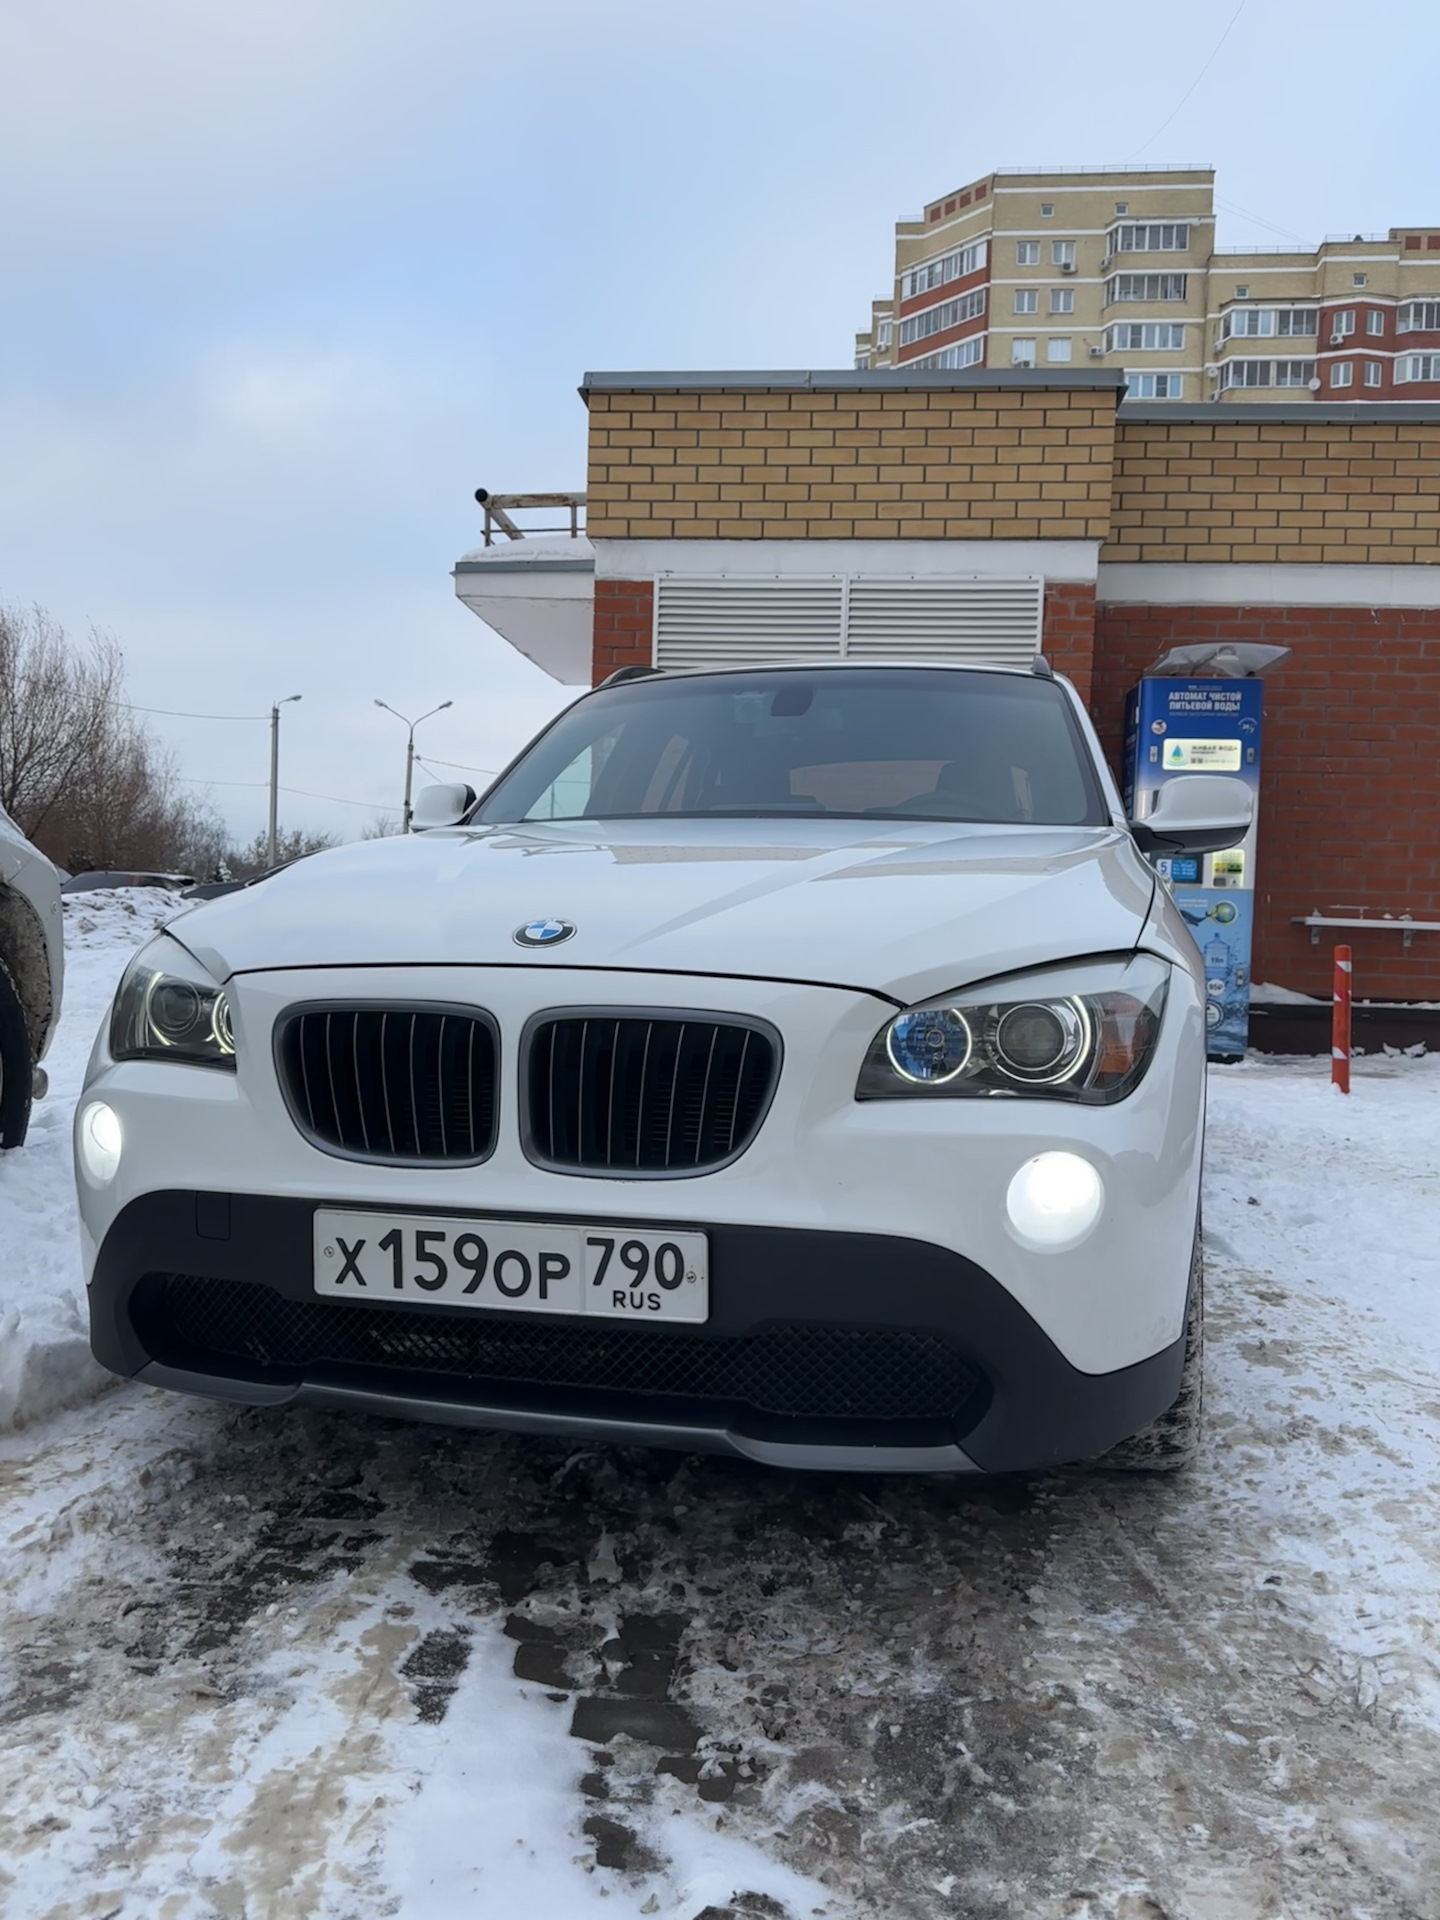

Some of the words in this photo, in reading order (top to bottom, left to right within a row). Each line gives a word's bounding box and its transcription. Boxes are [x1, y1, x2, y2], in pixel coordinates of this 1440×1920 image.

[1168, 691, 1207, 700] АВТОМАТ
[1208, 690, 1242, 701] ЧИСТОЙ
[1168, 700, 1213, 711] ПИТЬЕВОЙ
[1213, 701, 1241, 712] ВОДЫ
[1160, 861, 1168, 873] 5
[586, 1237, 685, 1290] 790
[612, 1290, 662, 1311] RUS
